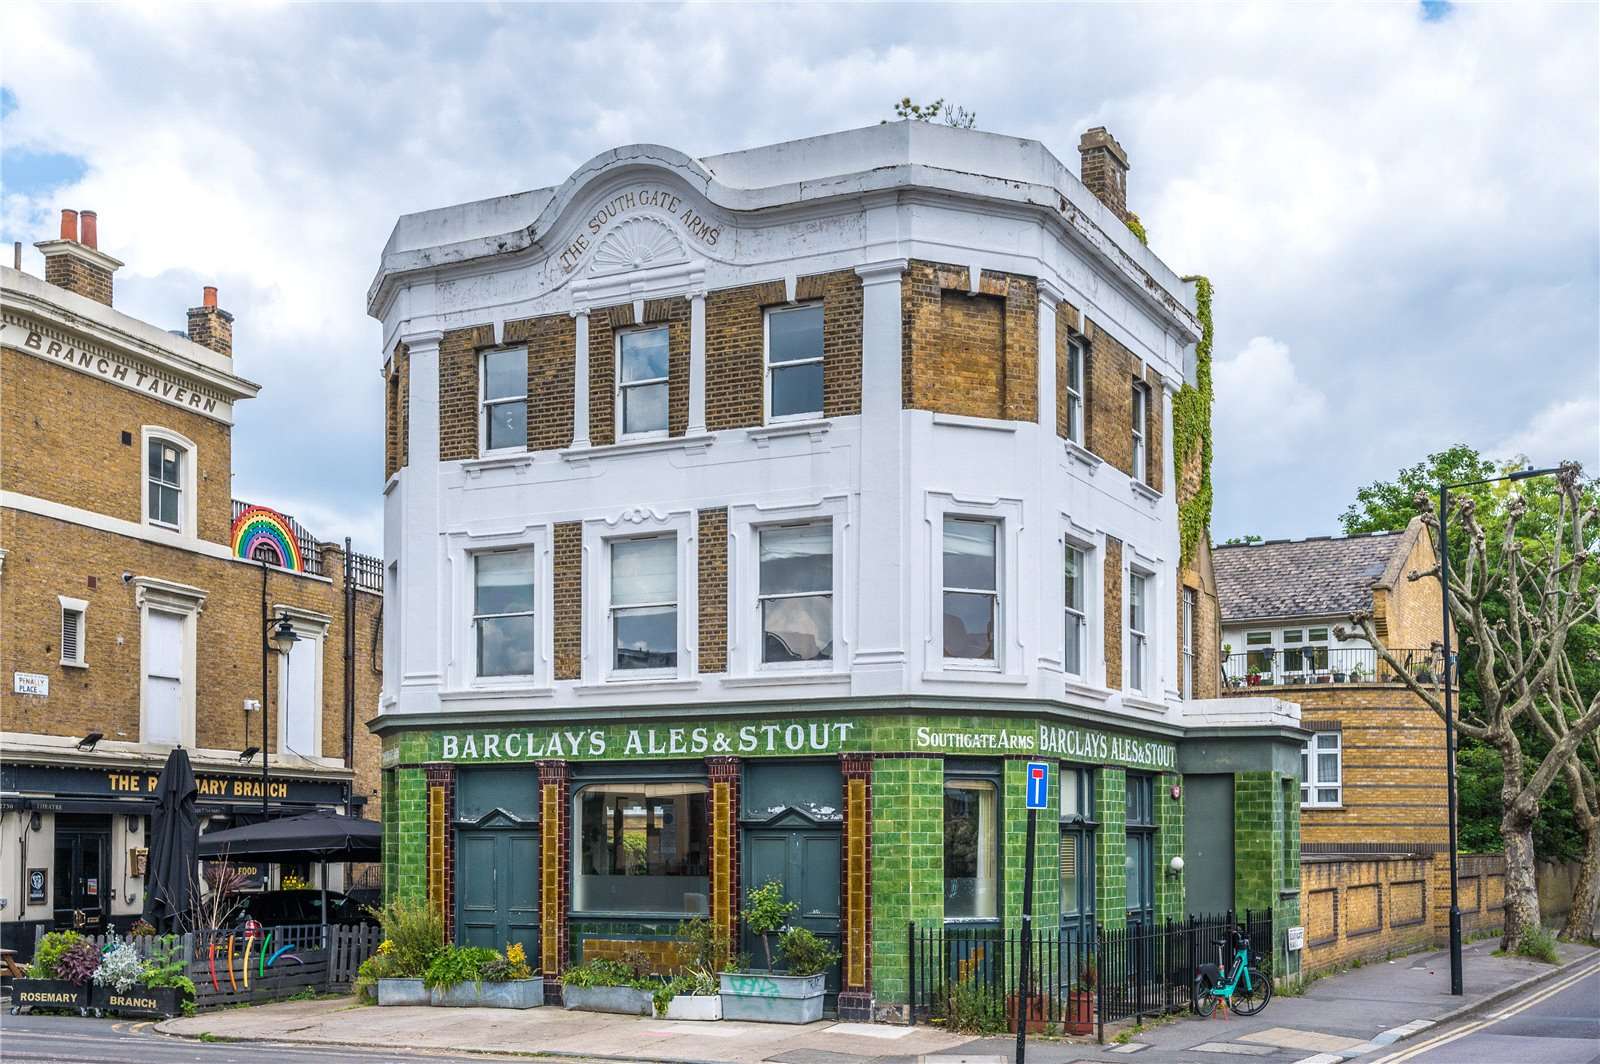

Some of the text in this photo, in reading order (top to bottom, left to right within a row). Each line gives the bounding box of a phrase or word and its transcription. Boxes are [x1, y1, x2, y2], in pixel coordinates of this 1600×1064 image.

[559, 234, 590, 274] THE
[679, 209, 720, 246] ARMS
[24, 331, 217, 413] BRANCH TAVERN
[442, 729, 607, 759] BARCLAY'S
[1039, 725, 1108, 759] BARCLAY'S
[108, 774, 140, 792] THE
[238, 866, 257, 876] FOOD
[20, 992, 78, 1003] ROSEMARY
[109, 996, 157, 1009] BRANCH
